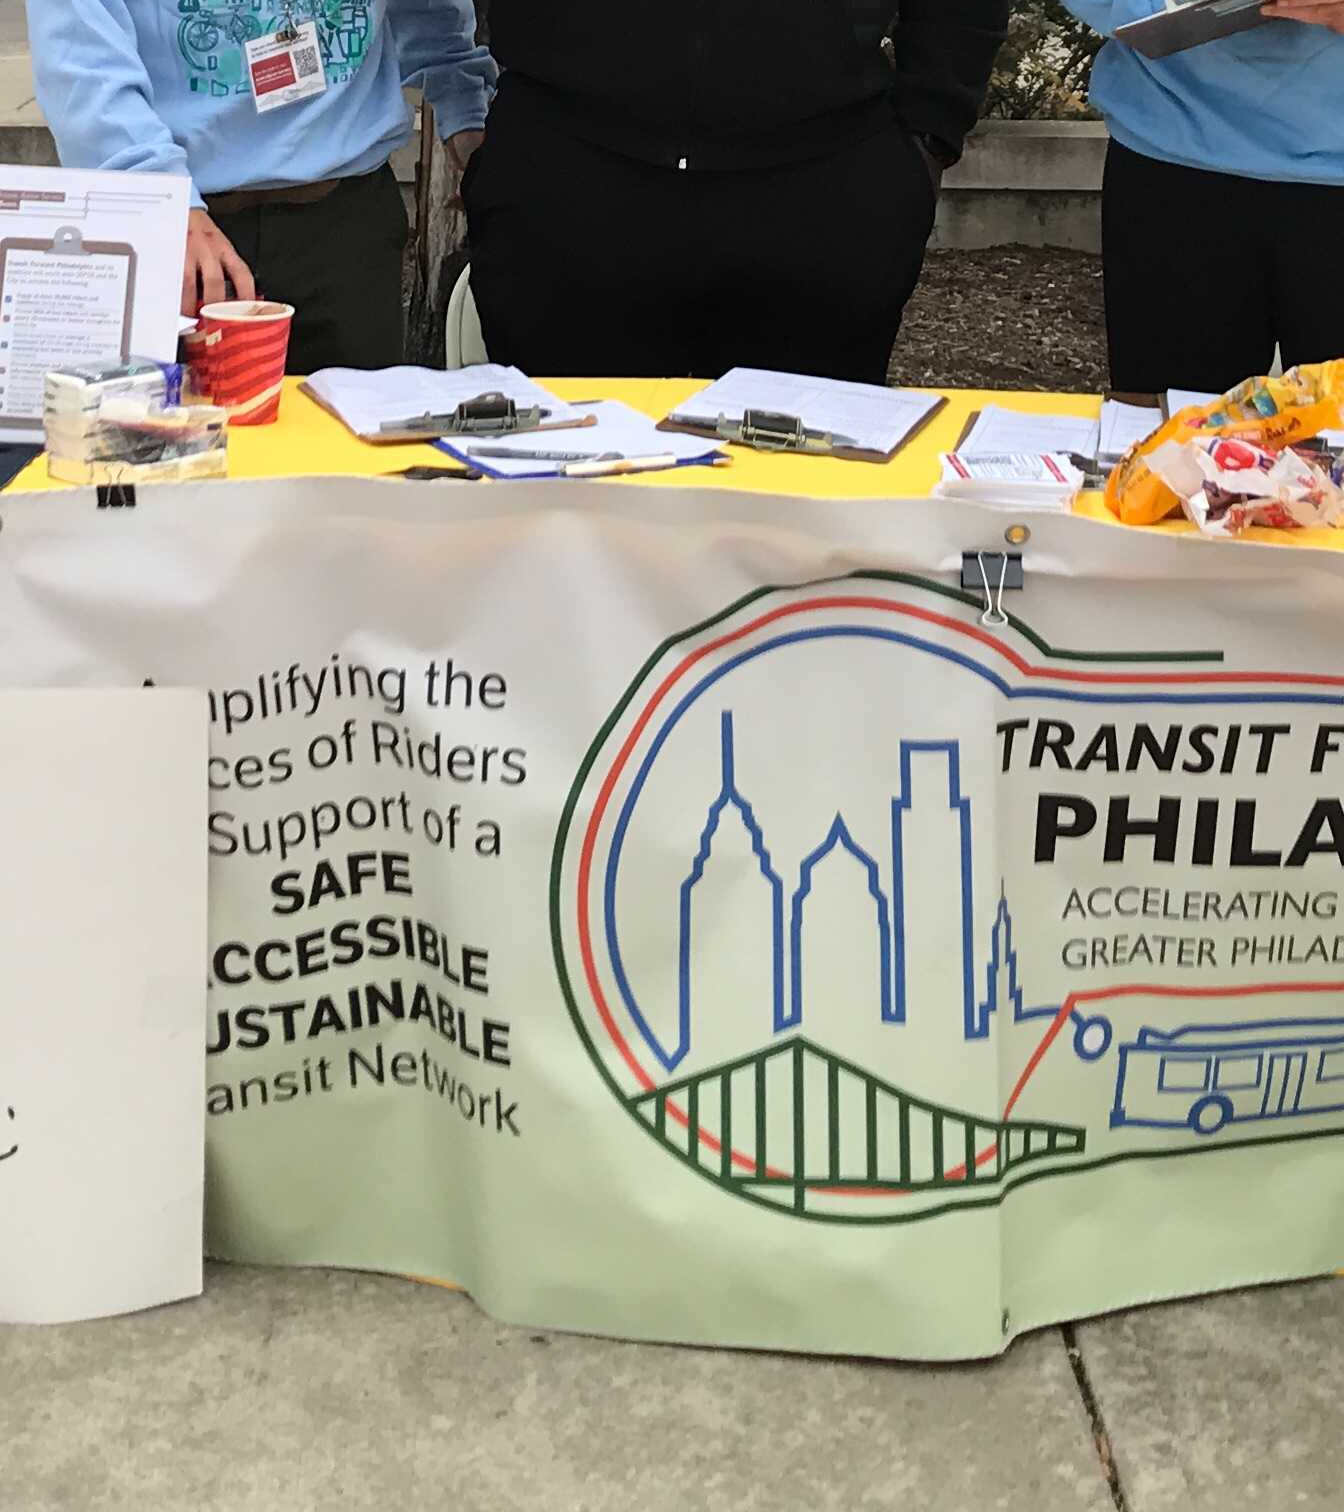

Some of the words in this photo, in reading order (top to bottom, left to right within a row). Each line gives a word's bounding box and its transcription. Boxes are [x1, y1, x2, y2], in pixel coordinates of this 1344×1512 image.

[208, 653, 406, 734] plifying
[425, 659, 507, 708] the
[208, 748, 293, 789] ces
[308, 719, 356, 769] of
[371, 720, 527, 785] Riders
[996, 717, 1291, 774] TRANSIT
[208, 791, 413, 861] Support
[423, 804, 461, 852] of
[475, 819, 501, 857] a
[271, 850, 413, 915] SAFE
[1062, 885, 1338, 921] ACCELERATING
[208, 914, 489, 995] CCESSIBLE
[1062, 933, 1216, 968] GREATER
[206, 978, 512, 1068] USTAINABLE
[208, 1056, 334, 1115] ansit
[348, 1043, 521, 1138] Network
